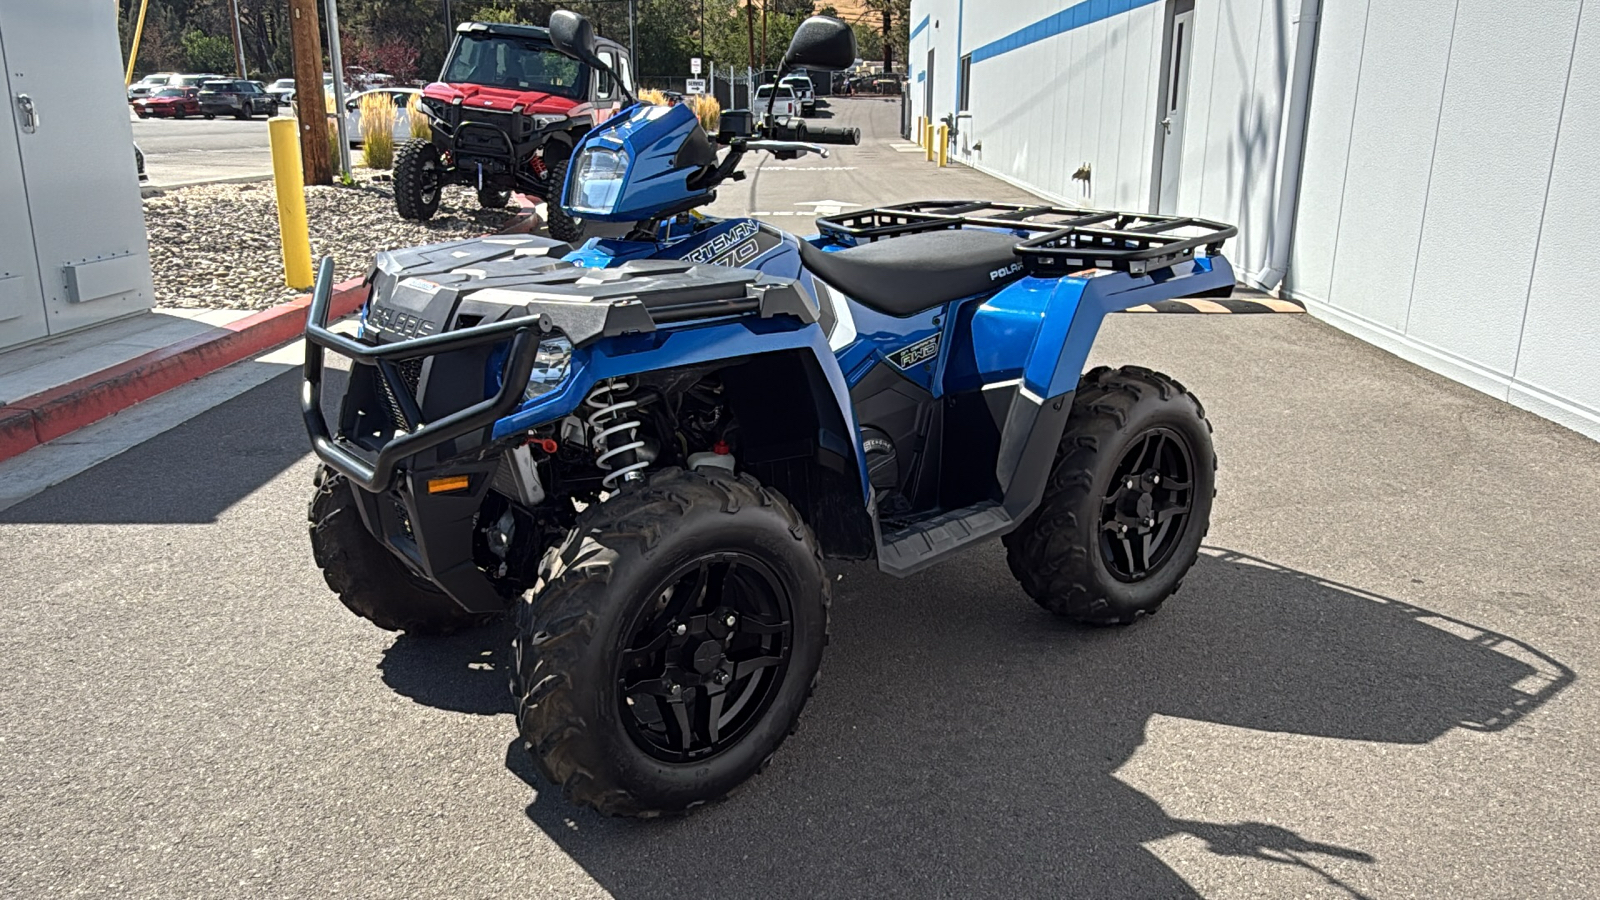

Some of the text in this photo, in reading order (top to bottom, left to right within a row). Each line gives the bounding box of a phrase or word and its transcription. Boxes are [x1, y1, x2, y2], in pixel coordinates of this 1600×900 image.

[711, 238, 759, 267] 70
[372, 305, 436, 340] POLARIS
[900, 343, 937, 368] AWD
